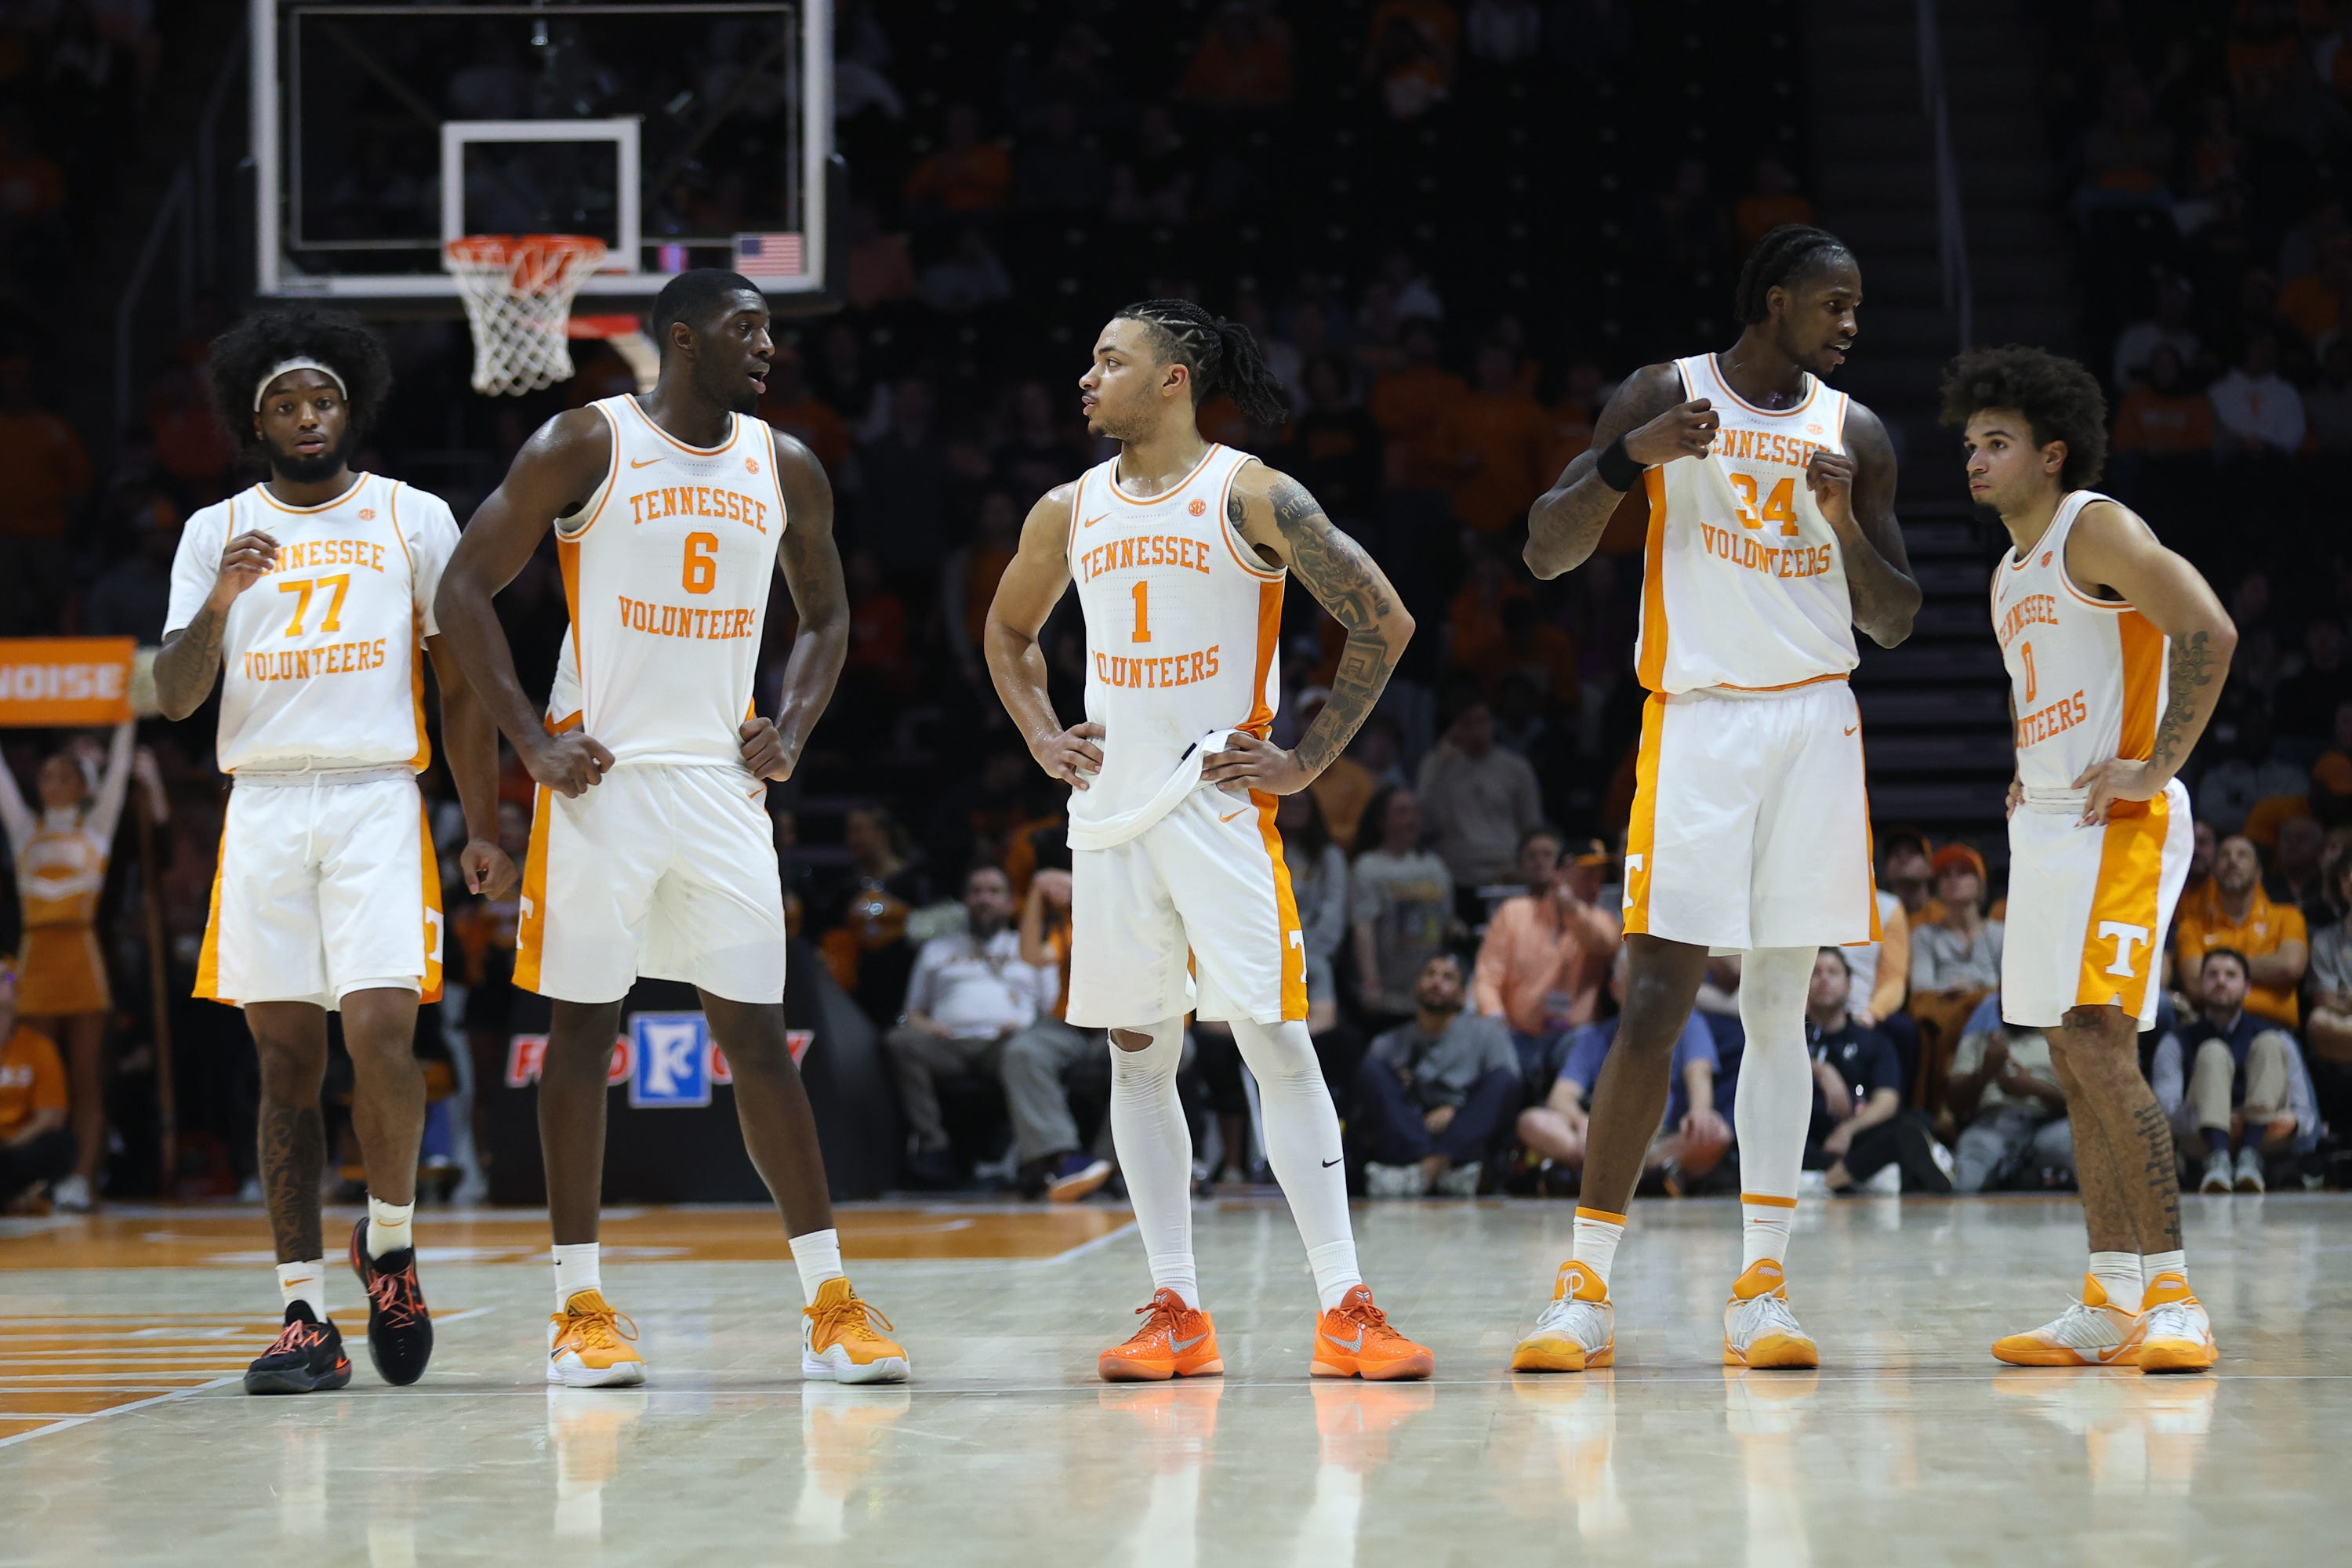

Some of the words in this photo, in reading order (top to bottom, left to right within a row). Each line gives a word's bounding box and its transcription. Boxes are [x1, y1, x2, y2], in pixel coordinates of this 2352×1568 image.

[630, 486, 767, 535] TENNESSEE
[1189, 499, 1206, 517] SEC
[1730, 472, 1798, 536] 34
[259, 540, 386, 577] NNESSEE
[682, 532, 719, 595] 6
[1081, 535, 1210, 585] TENNESSEE
[1700, 521, 1831, 578] VOLUNTEERS
[278, 574, 350, 638] 77
[1131, 580, 1152, 643] 1
[244, 638, 387, 681] VOLUNTEERS
[1091, 644, 1220, 688] OUNTEERS
[2020, 641, 2037, 704] 0
[2097, 920, 2150, 978] T
